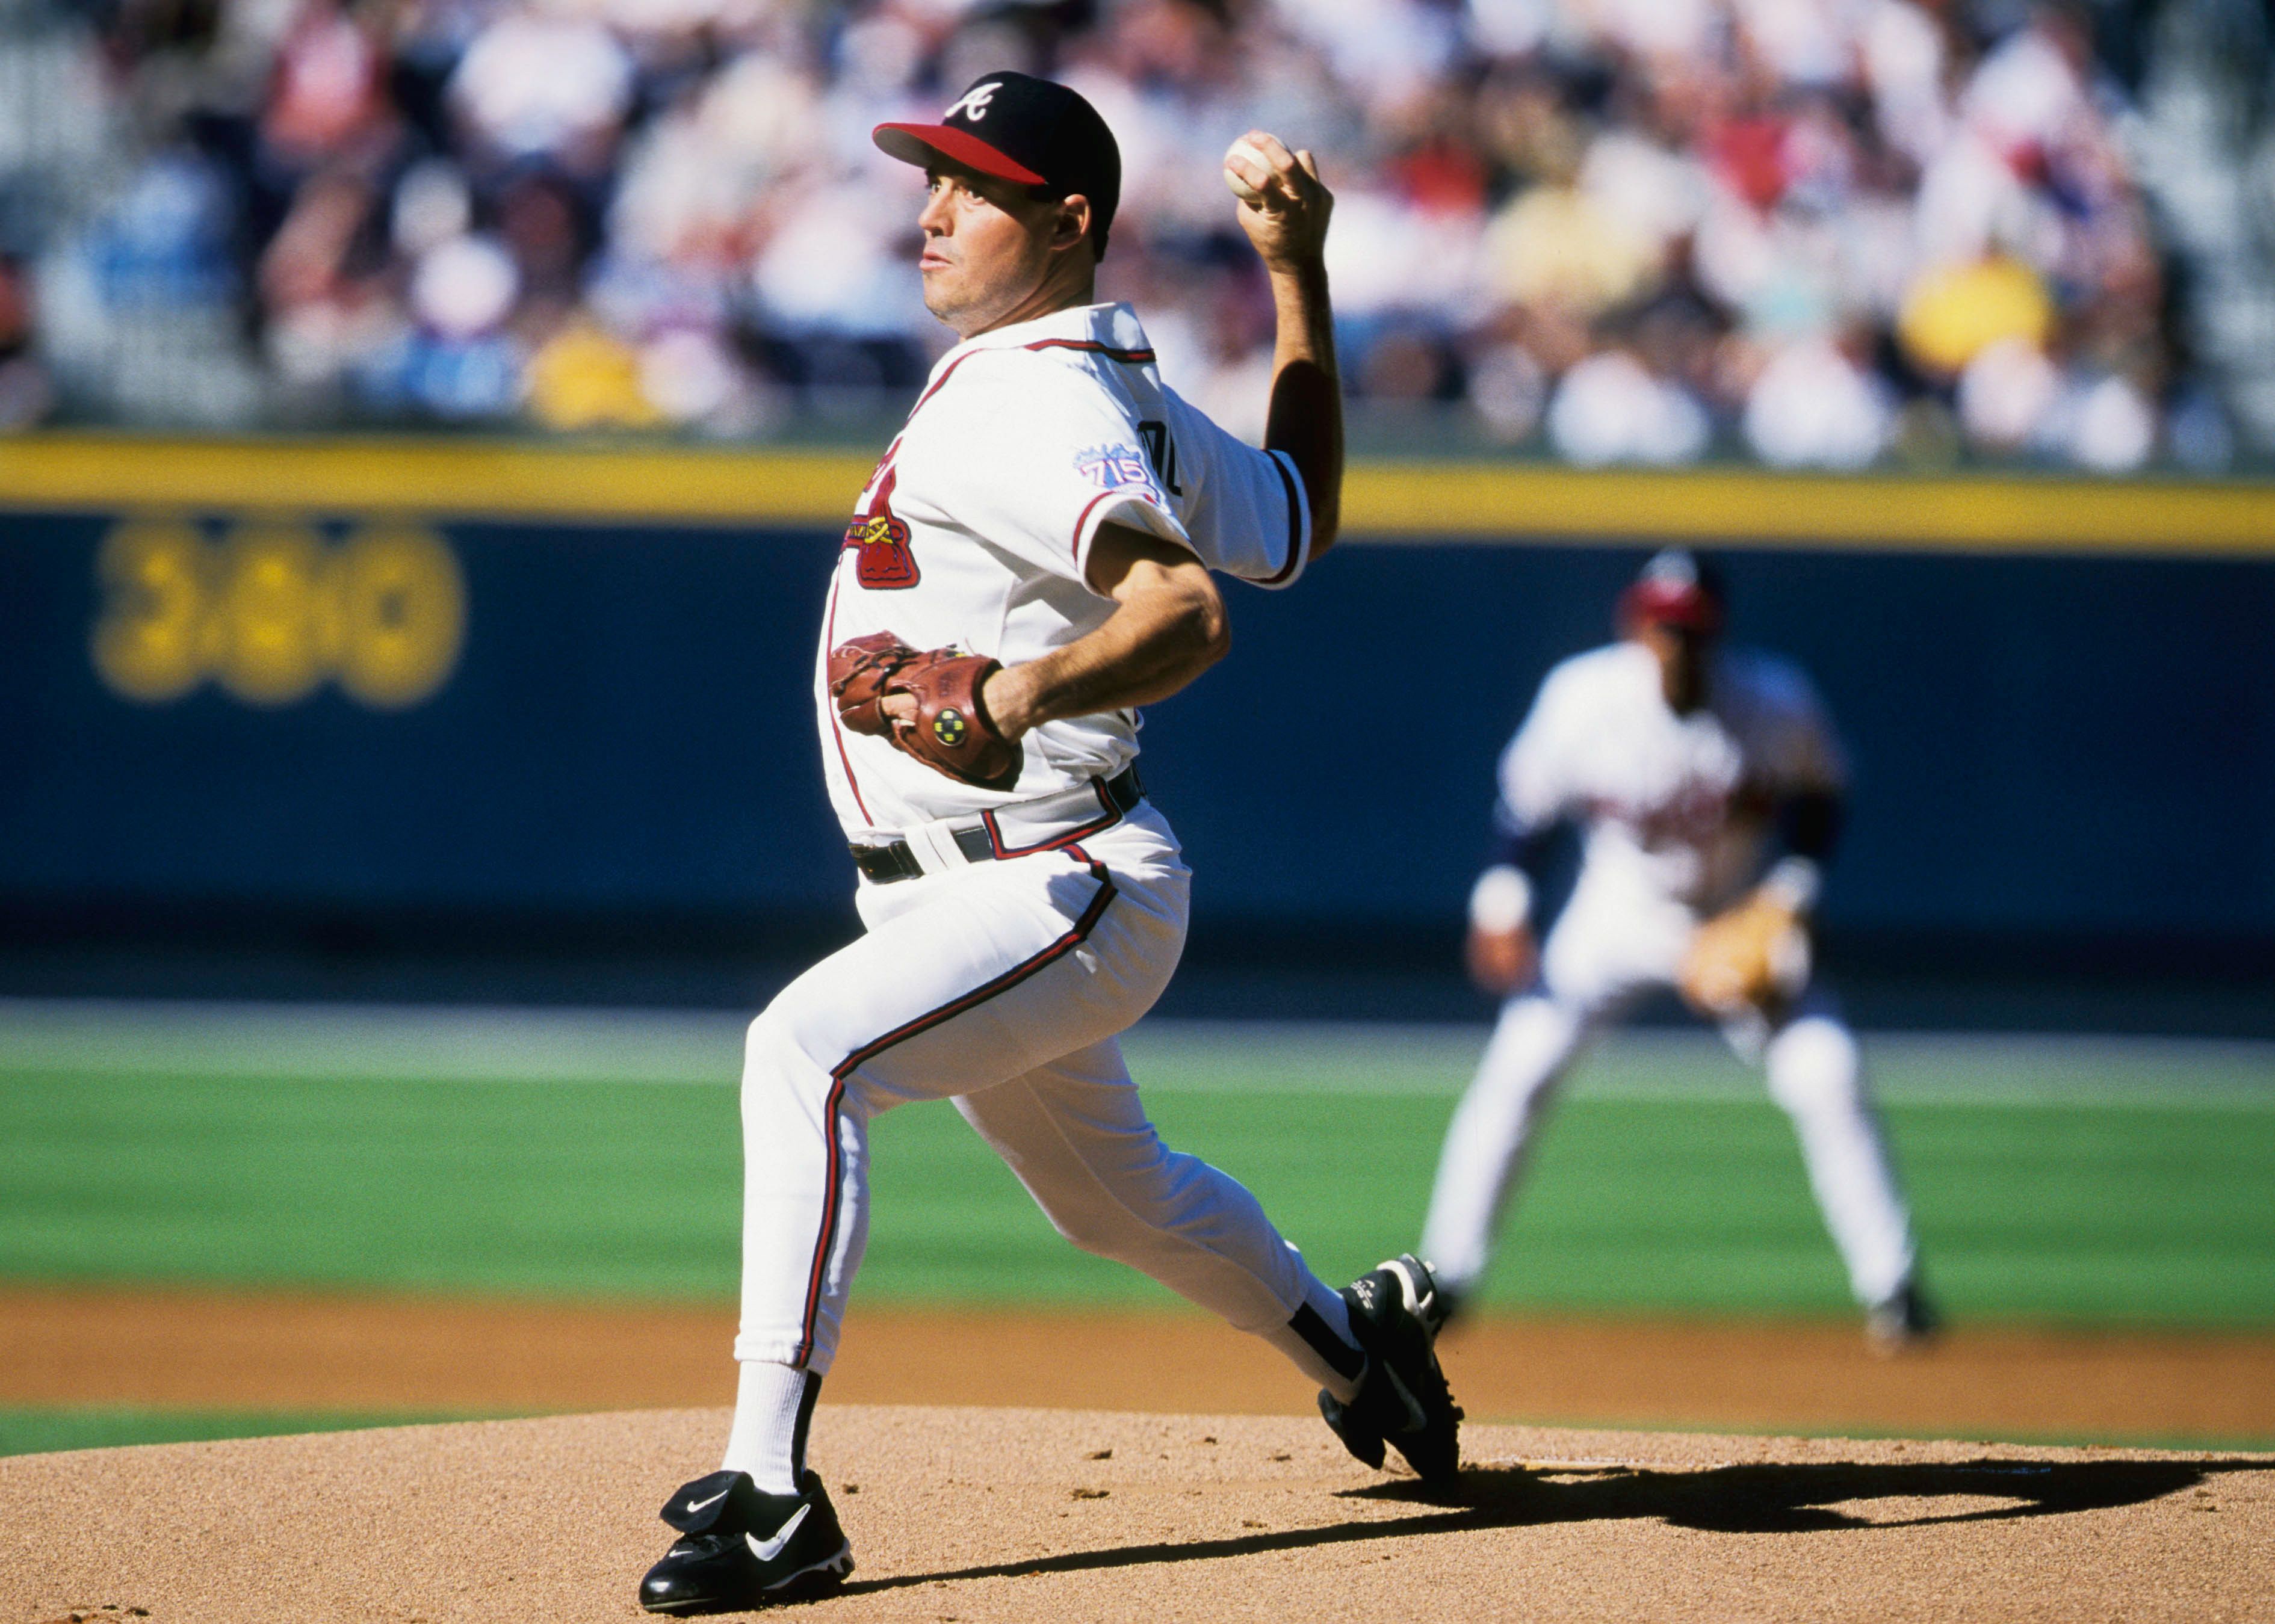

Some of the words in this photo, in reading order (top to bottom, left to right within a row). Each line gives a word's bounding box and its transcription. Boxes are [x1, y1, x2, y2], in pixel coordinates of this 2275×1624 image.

[944, 82, 1003, 122] A
[1079, 458, 1148, 487] 715
[92, 519, 466, 706] 380
